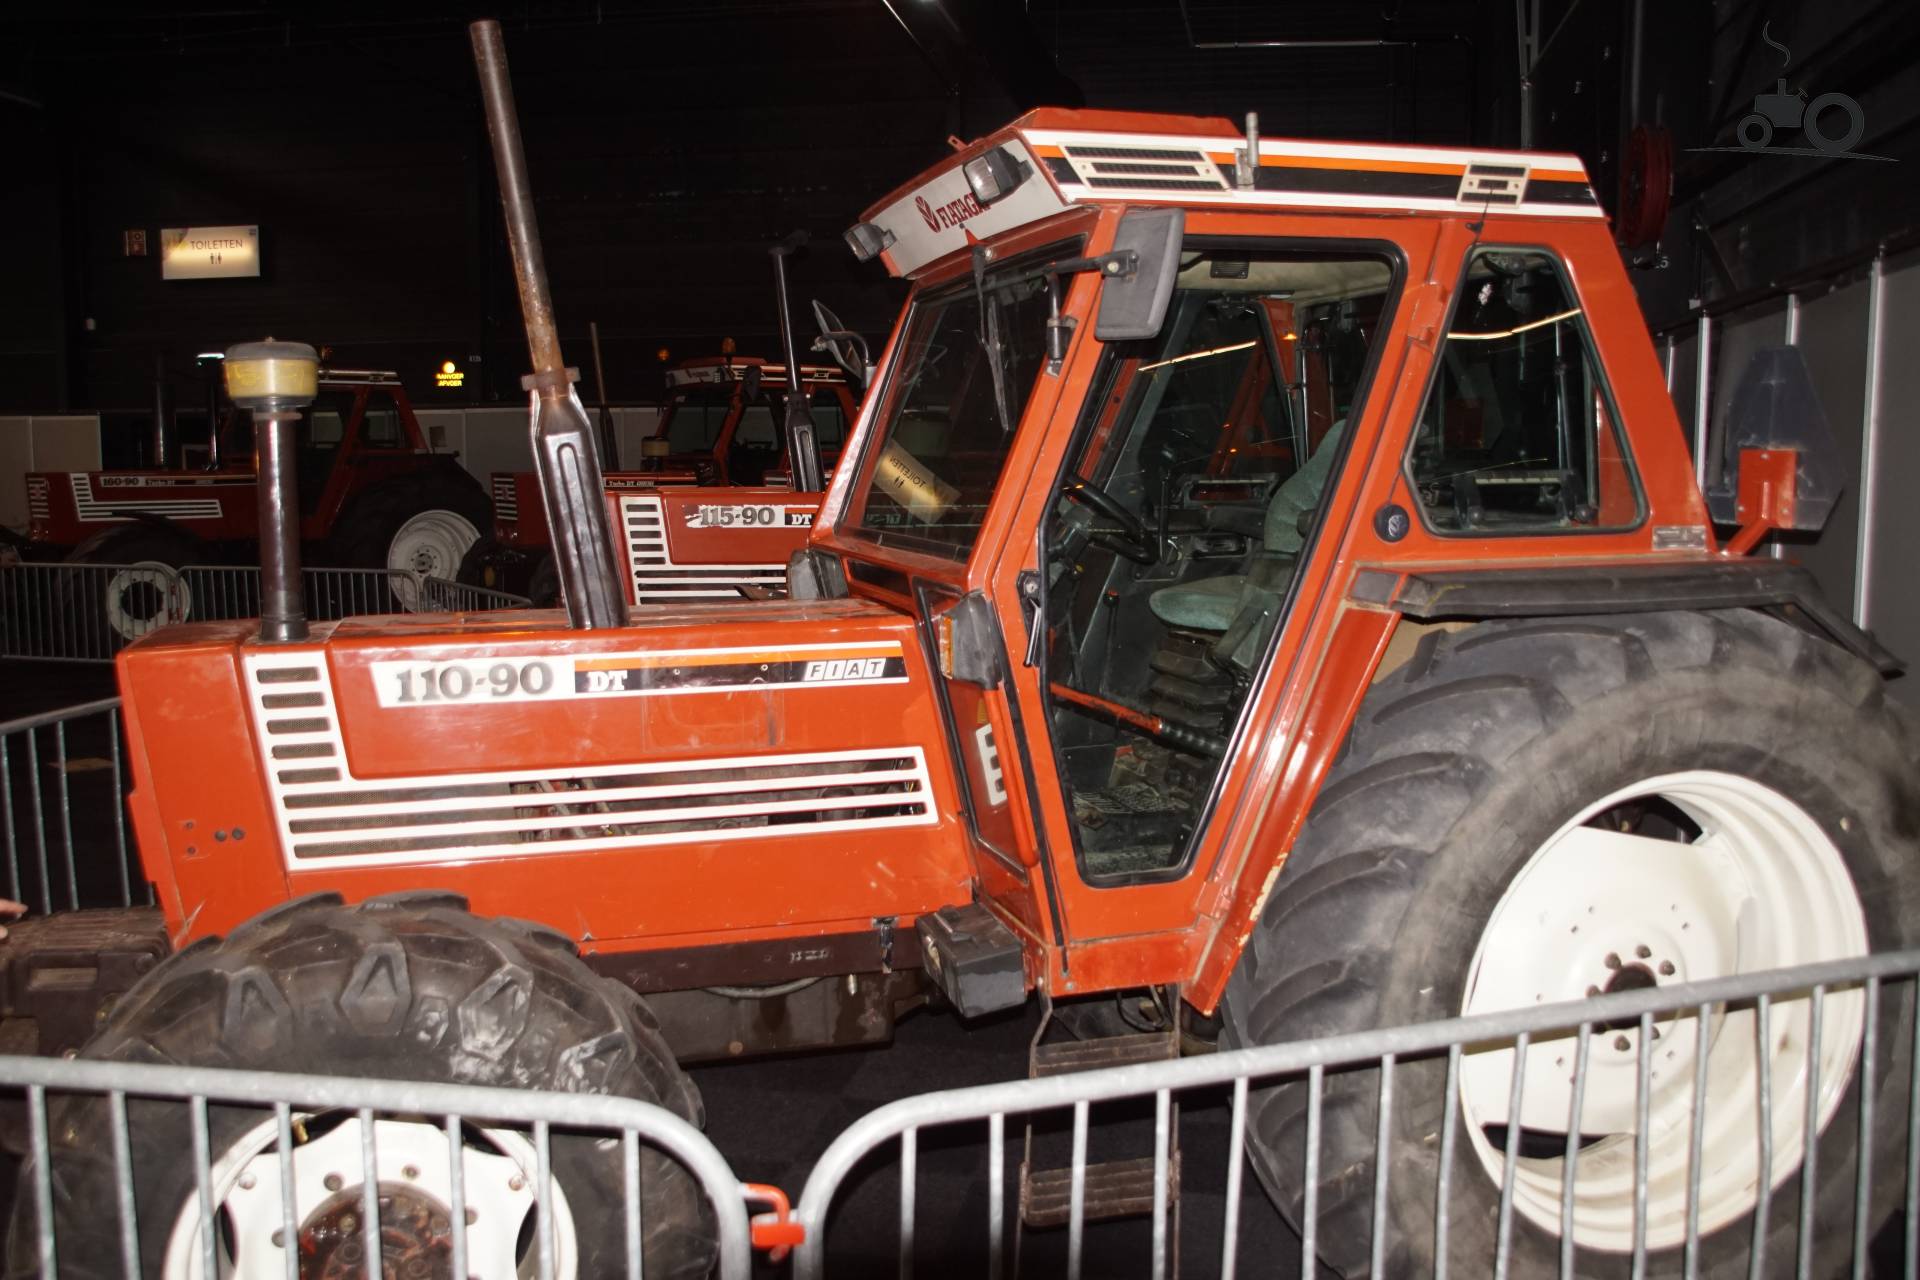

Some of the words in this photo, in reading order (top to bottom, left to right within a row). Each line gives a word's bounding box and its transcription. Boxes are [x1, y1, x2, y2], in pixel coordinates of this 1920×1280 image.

[936, 193, 991, 229] FIATAG
[191, 240, 243, 250] TOILETTEN
[701, 506, 775, 526] 115-90
[791, 513, 813, 525] DT
[397, 661, 554, 702] 110-90
[588, 670, 628, 692] DT
[808, 660, 885, 679] FIAT
